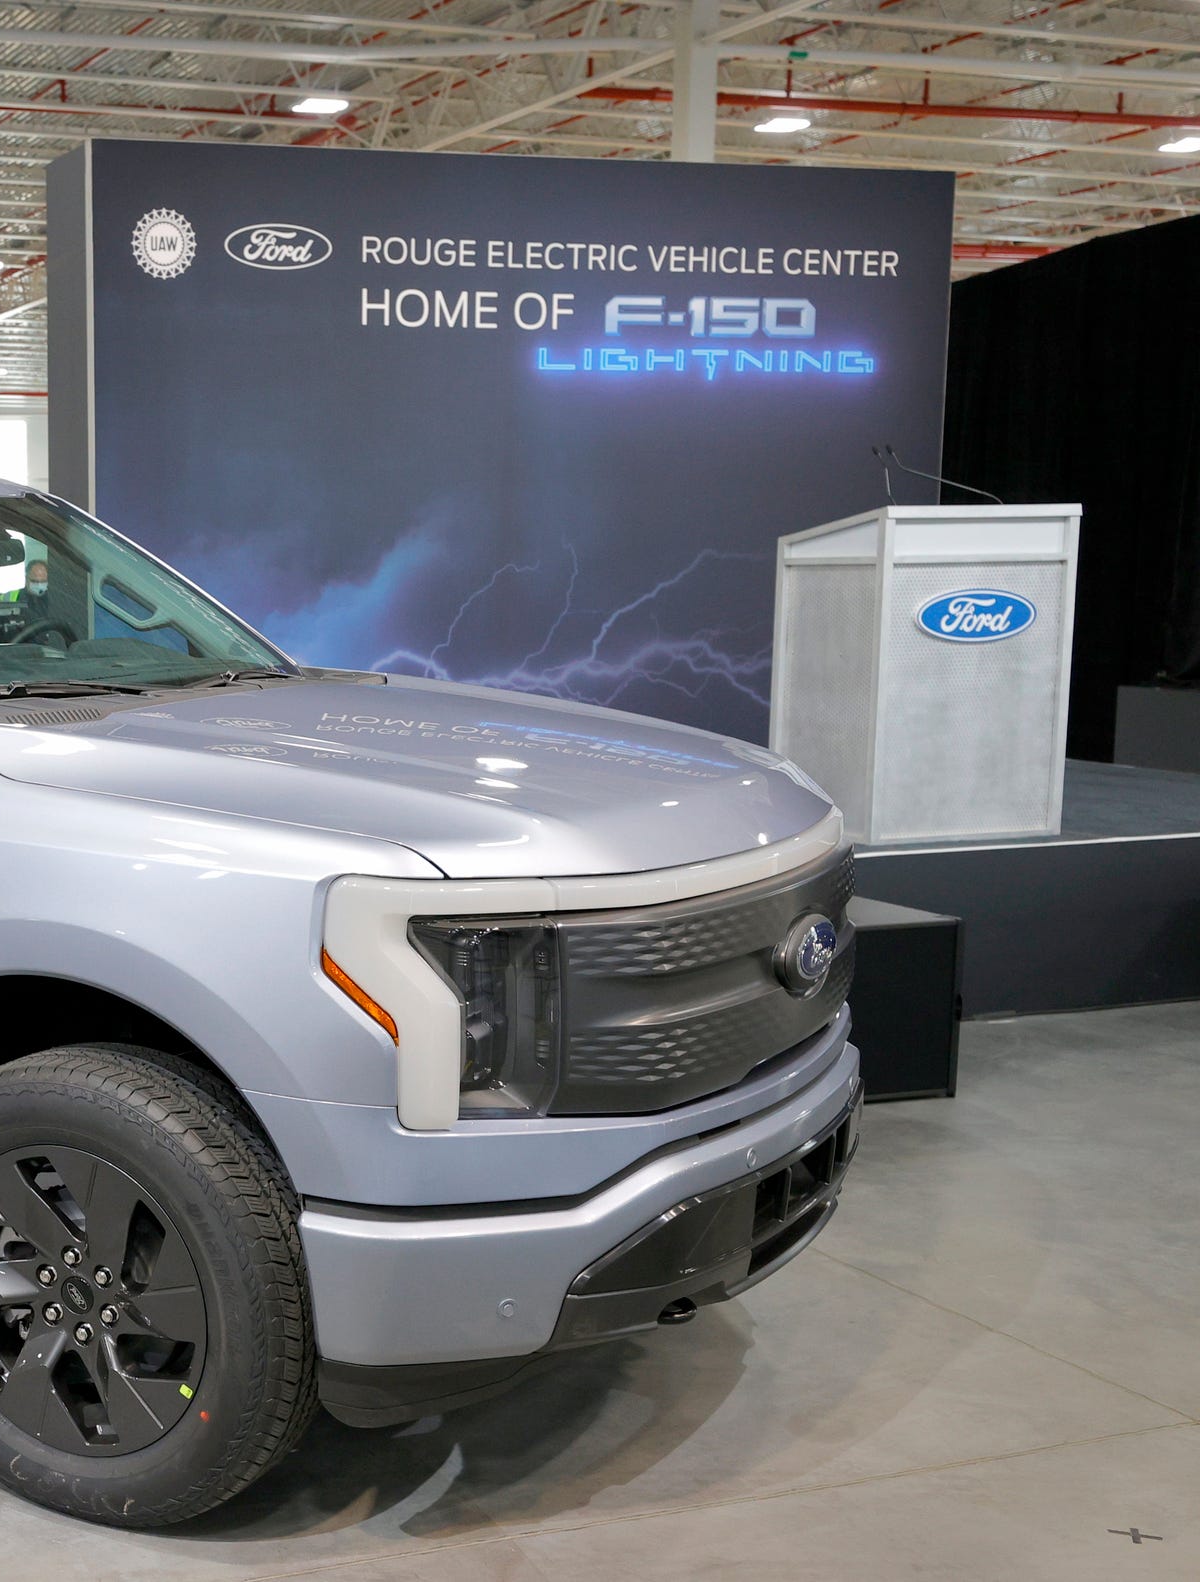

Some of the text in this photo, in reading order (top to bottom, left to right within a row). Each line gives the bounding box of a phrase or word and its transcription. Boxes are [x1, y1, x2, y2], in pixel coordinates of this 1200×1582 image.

[150, 236, 178, 252] UAW
[243, 228, 314, 263] Ford
[361, 235, 899, 278] ROUGE ELECTRIC VEHICLE CENTER
[361, 287, 816, 339] HOME OF F-150
[537, 346, 875, 381] LIGHTNING
[940, 597, 1014, 633] Ford
